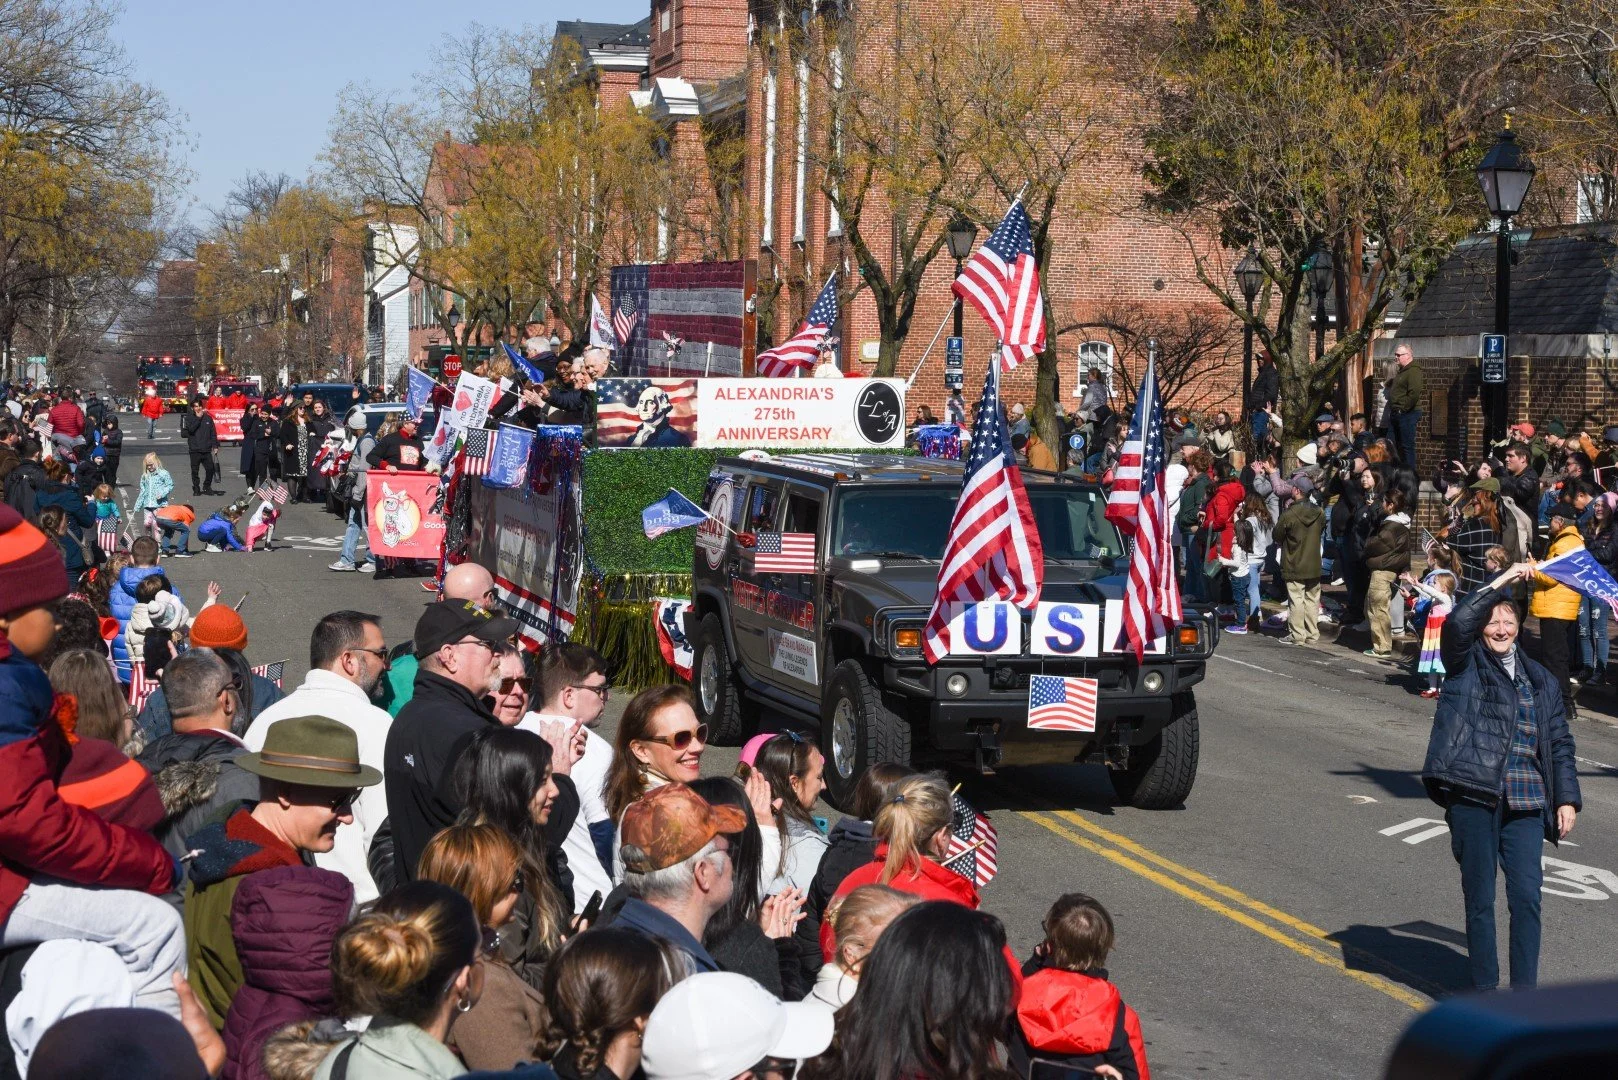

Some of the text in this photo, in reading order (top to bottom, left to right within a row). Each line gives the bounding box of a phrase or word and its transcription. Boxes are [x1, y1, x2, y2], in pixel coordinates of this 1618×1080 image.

[952, 339, 958, 348] P
[1490, 338, 1498, 352] P
[444, 362, 462, 371] STOP
[714, 387, 834, 400] ALEXANDRIA'S
[754, 407, 796, 420] 275th
[716, 427, 833, 440] ANNIVERSARY
[1074, 436, 1081, 448] P
[732, 578, 814, 632] YATES CORNER
